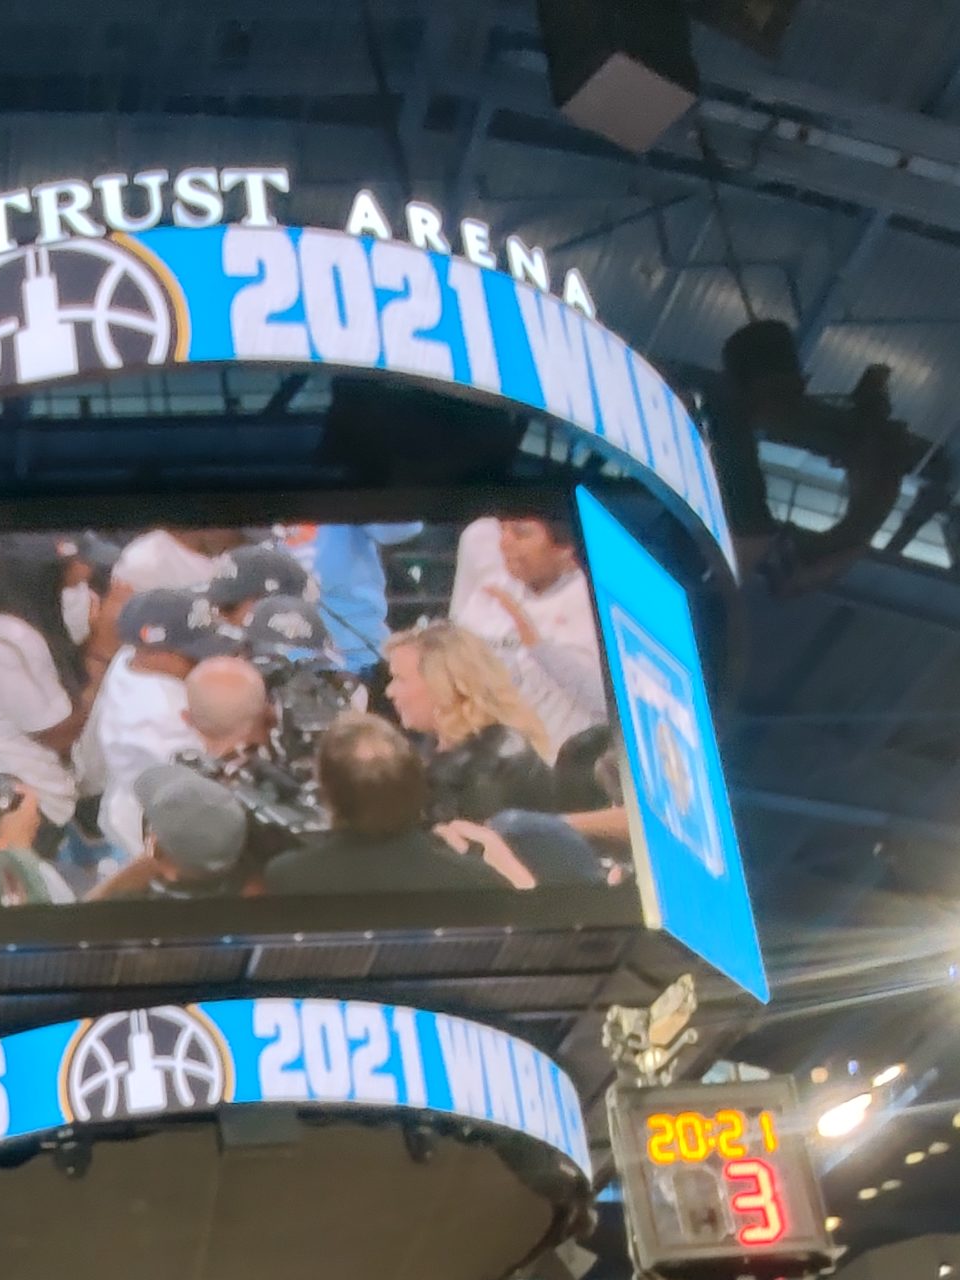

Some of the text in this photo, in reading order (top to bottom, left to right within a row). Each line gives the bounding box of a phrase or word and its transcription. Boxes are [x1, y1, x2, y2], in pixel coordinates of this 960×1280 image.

[221, 224, 503, 392] 2021
[346, 188, 597, 321] ARENA
[252, 998, 428, 1109] 2021
[435, 1012, 573, 1158] WNBA
[646, 1109, 777, 1165] 20:21
[723, 1157, 787, 1246] 3
